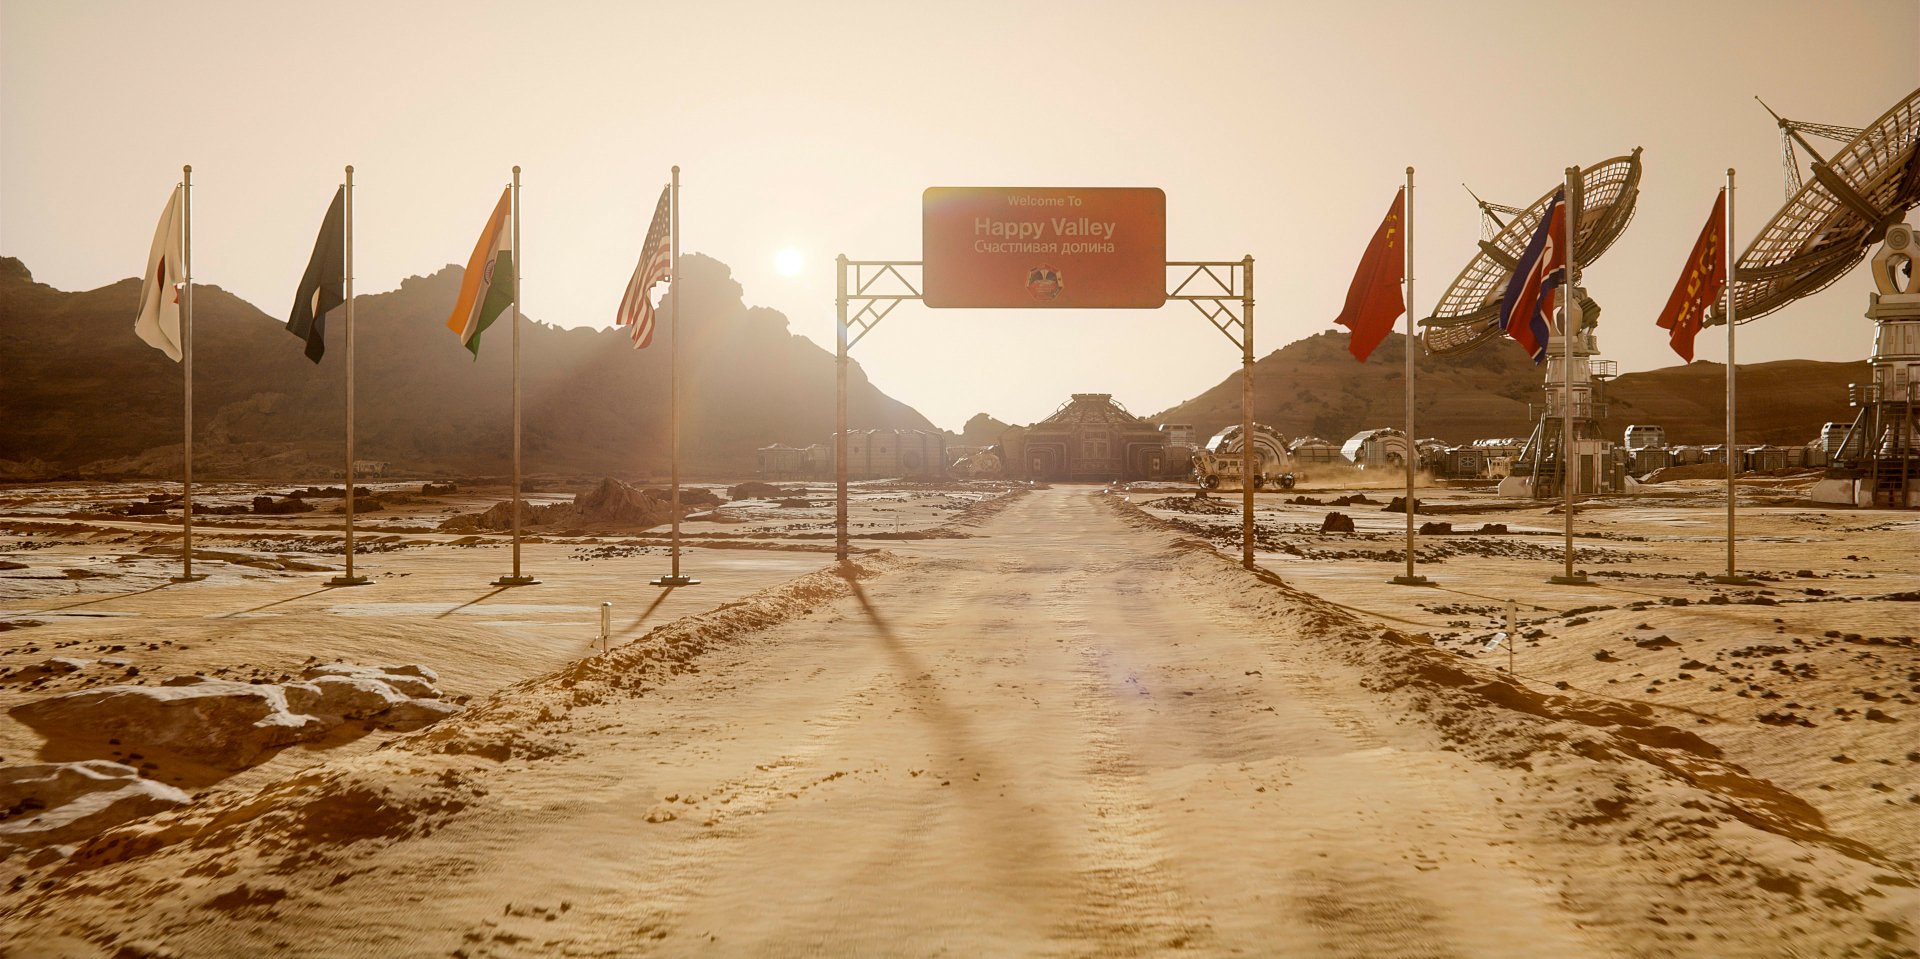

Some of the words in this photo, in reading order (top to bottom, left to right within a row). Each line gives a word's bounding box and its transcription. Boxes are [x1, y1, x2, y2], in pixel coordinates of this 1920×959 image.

[1007, 195, 1065, 207] Welcome
[1067, 195, 1082, 207] To
[974, 217, 1045, 240] Happy
[1051, 217, 1116, 240] Valley
[974, 239, 1057, 254] Счастливая
[1061, 243, 1115, 256] долина
